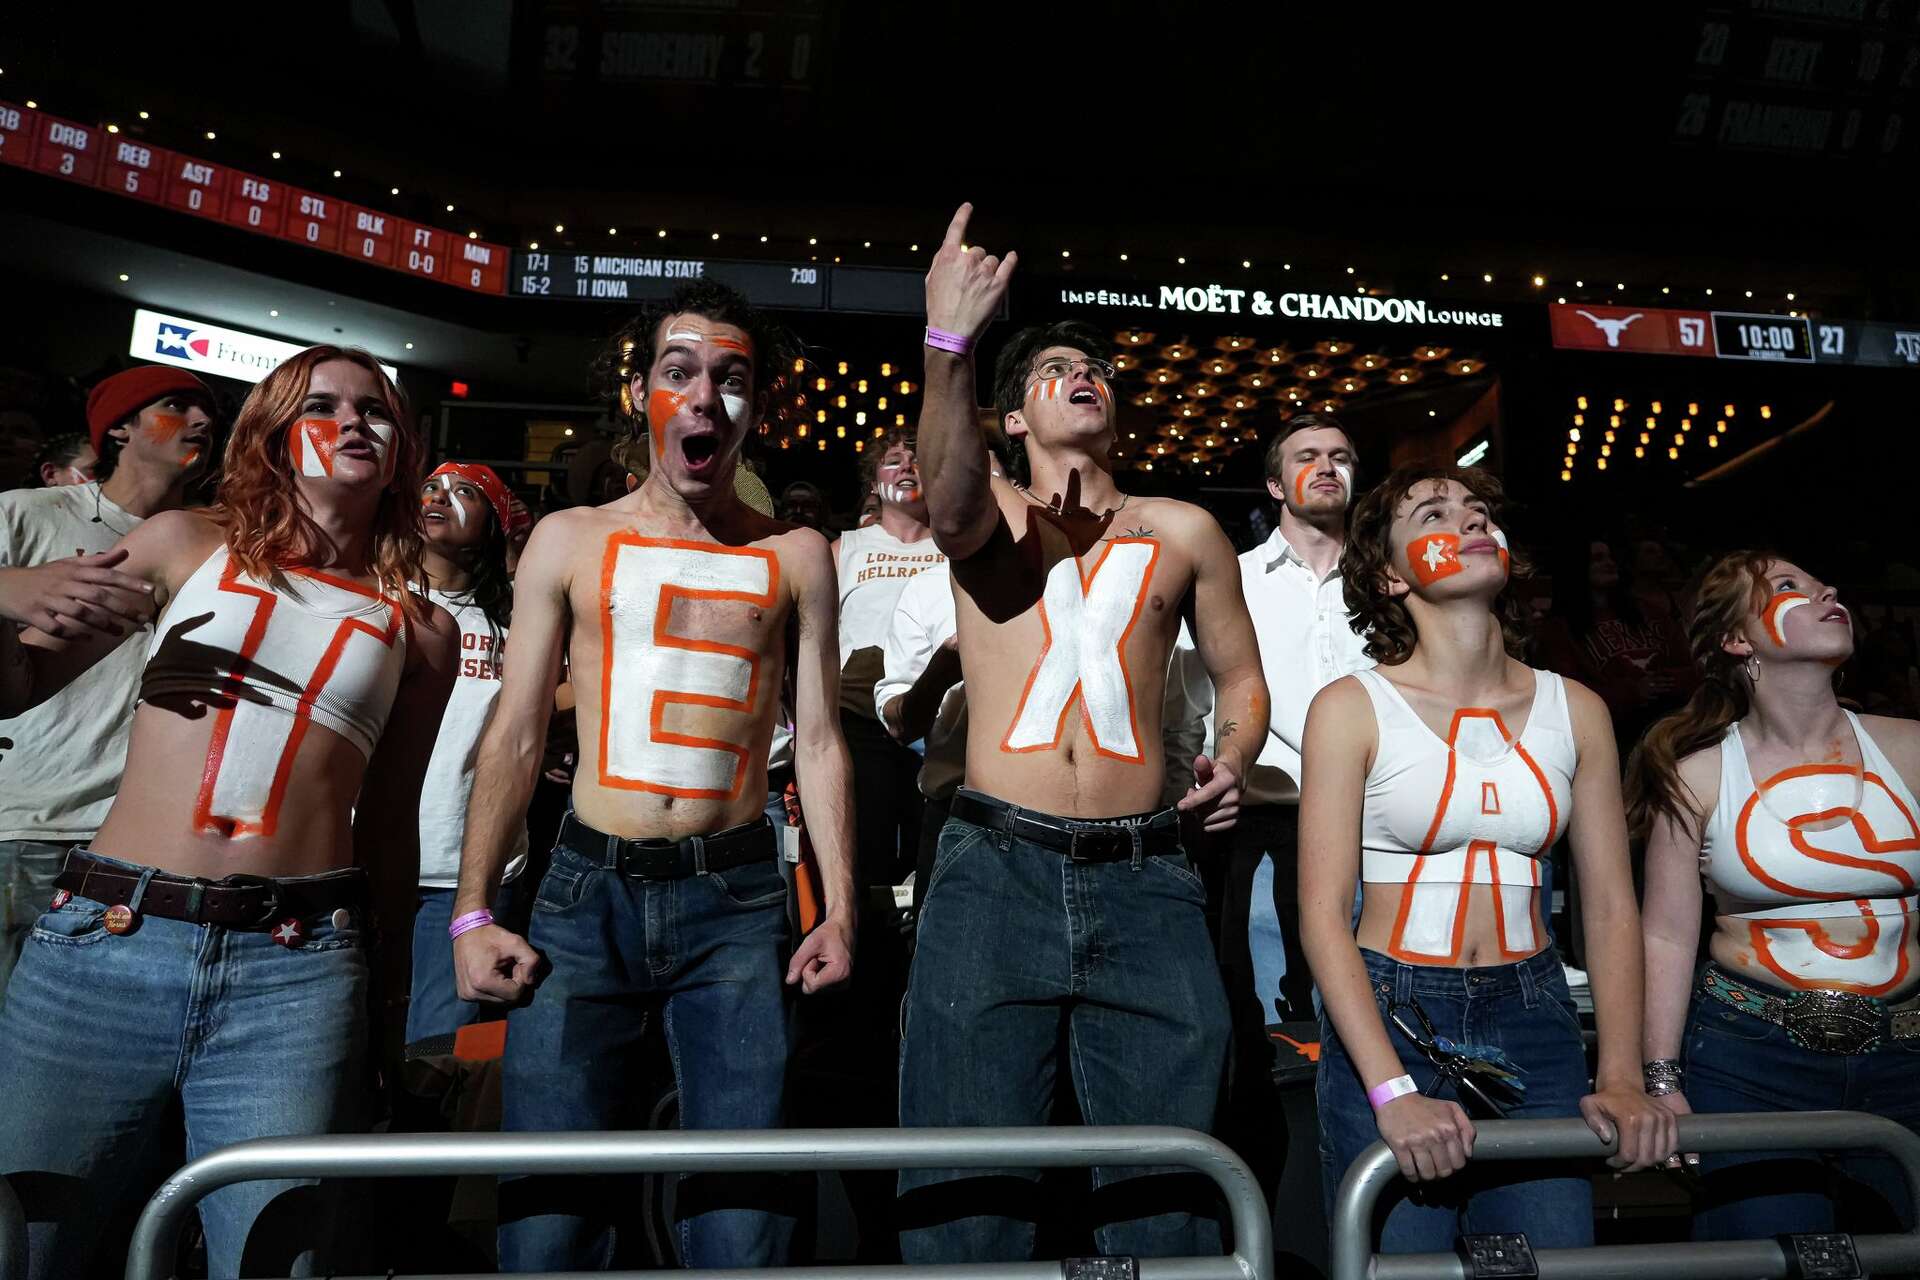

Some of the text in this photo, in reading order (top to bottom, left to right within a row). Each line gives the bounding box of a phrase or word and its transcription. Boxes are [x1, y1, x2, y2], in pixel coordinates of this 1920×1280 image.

[50, 122, 88, 150] DRB
[60, 153, 74, 175] 3
[118, 142, 151, 168] REB
[125, 171, 138, 192] 5
[181, 162, 214, 186] AST
[188, 189, 202, 210] 0
[241, 178, 270, 202] FLS
[248, 205, 261, 226] 0
[300, 195, 326, 219] STL
[306, 222, 319, 242] 0
[356, 210, 385, 236] BLK
[363, 238, 375, 257] 0
[414, 229, 432, 248] FT
[409, 251, 434, 274] 0-0
[464, 243, 491, 265] MIN
[471, 269, 481, 287] 8
[527, 254, 704, 279] 17-1 15 MICHIGAN STATE
[791, 268, 817, 284] 7:00
[522, 277, 628, 298] 15-2 11 IOWA
[1061, 284, 1504, 327] IMPÉRIAL MOËT & CHANDON LOUNGE
[1679, 318, 1705, 347] 57
[1738, 324, 1795, 350] 10:00
[1819, 325, 1845, 354] 27
[1000, 537, 1161, 766] X
[599, 528, 780, 801] E
[194, 543, 406, 837] T
[1389, 708, 1558, 964] A
[1736, 764, 1920, 997] S
